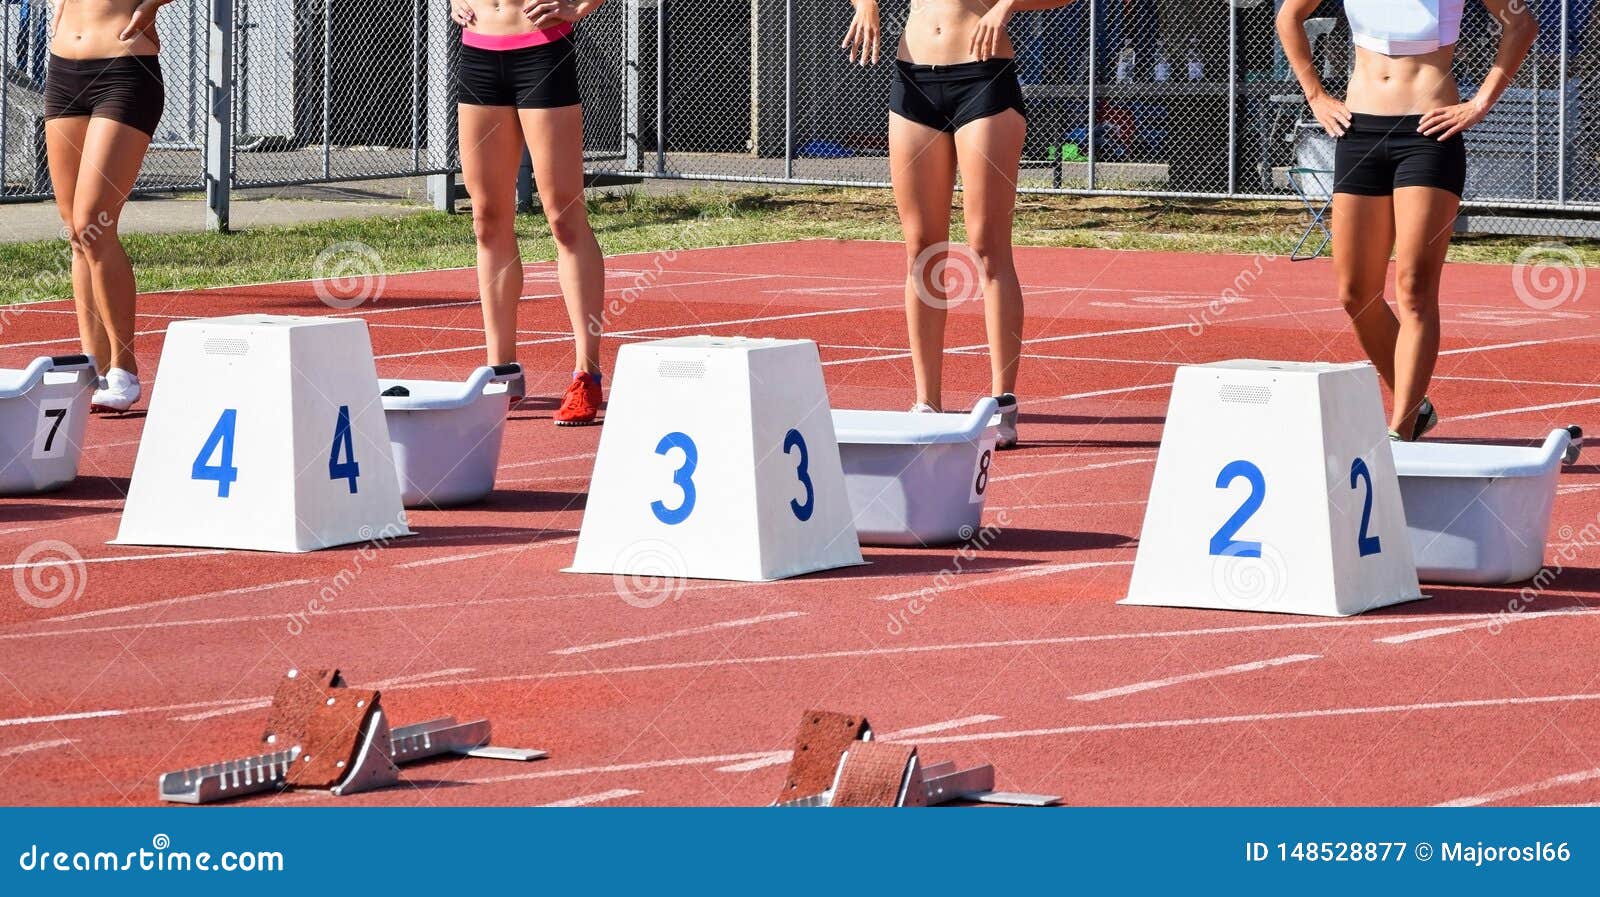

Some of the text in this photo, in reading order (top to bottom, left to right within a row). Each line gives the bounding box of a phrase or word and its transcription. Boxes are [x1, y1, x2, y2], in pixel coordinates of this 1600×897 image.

[44, 408, 67, 452] 7
[191, 408, 239, 499] 4
[329, 405, 360, 493] 4
[783, 429, 815, 522] 3
[975, 449, 991, 496] 8
[650, 431, 699, 526] 3
[1208, 459, 1267, 559] 2
[1350, 457, 1381, 557] 2
